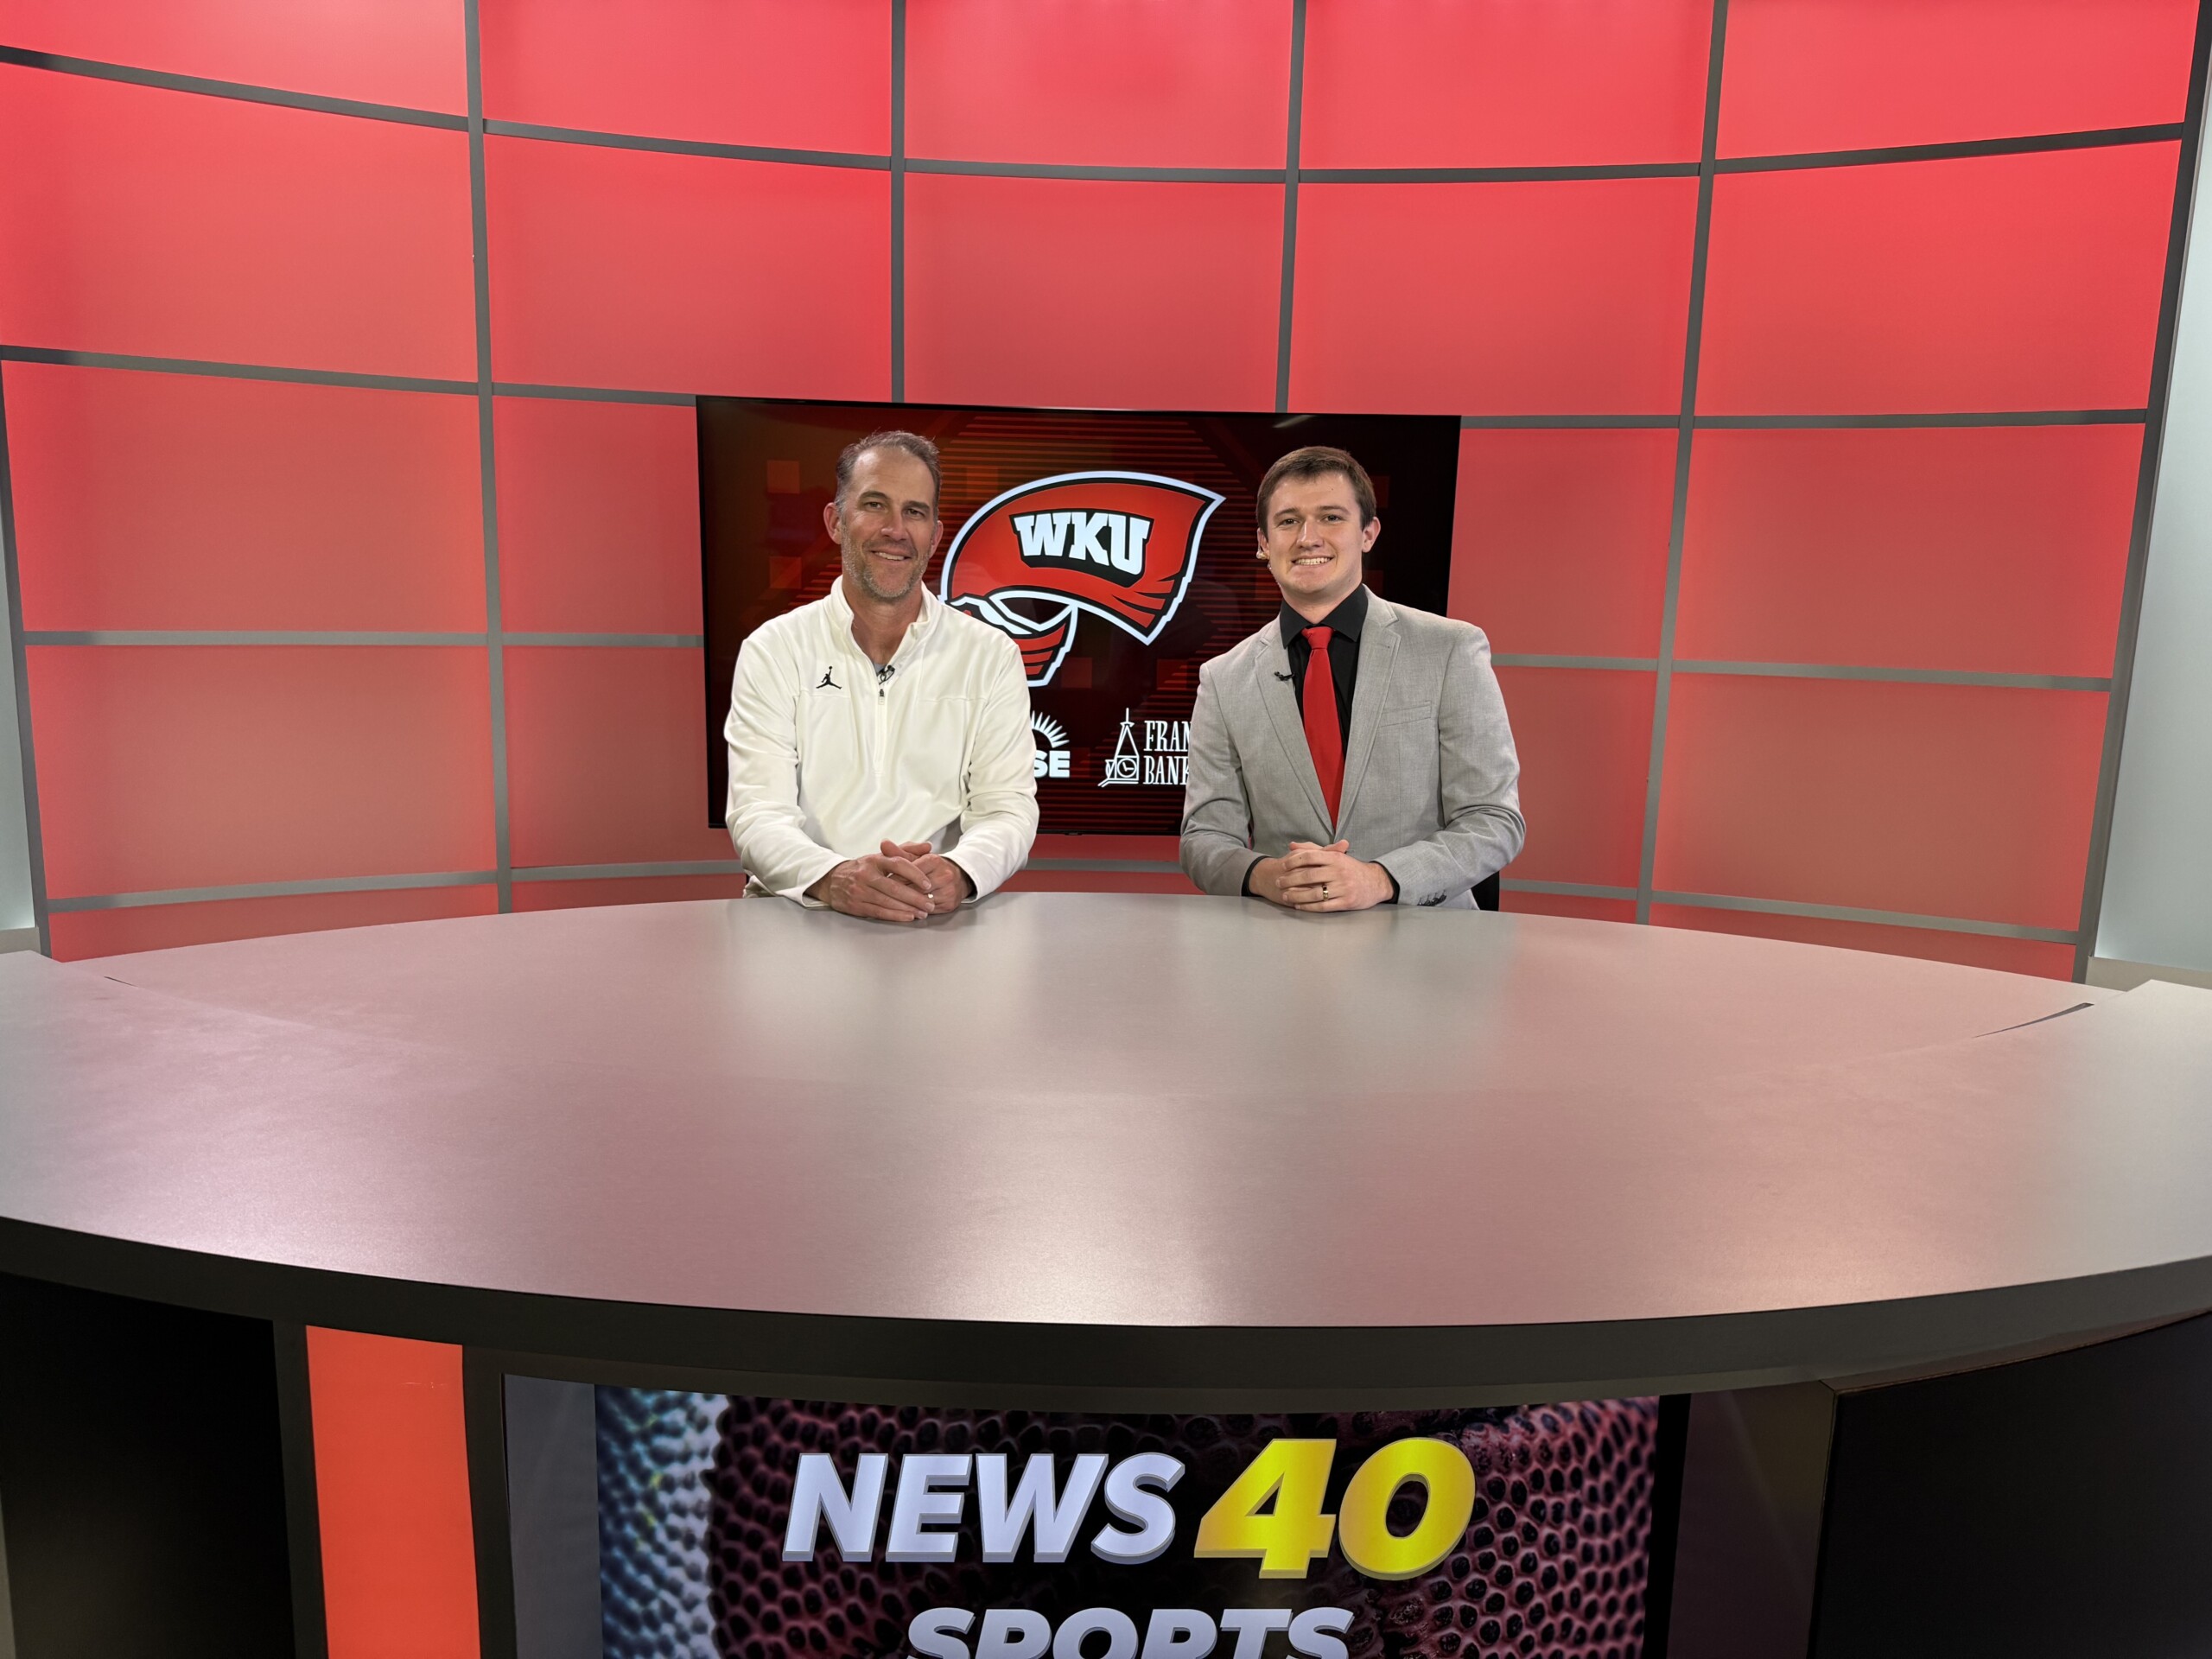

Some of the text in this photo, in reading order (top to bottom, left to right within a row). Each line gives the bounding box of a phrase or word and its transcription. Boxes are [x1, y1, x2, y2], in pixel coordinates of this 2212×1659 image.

[1014, 512, 1150, 575] WKU
[782, 1438, 1476, 1580] NEWS 40
